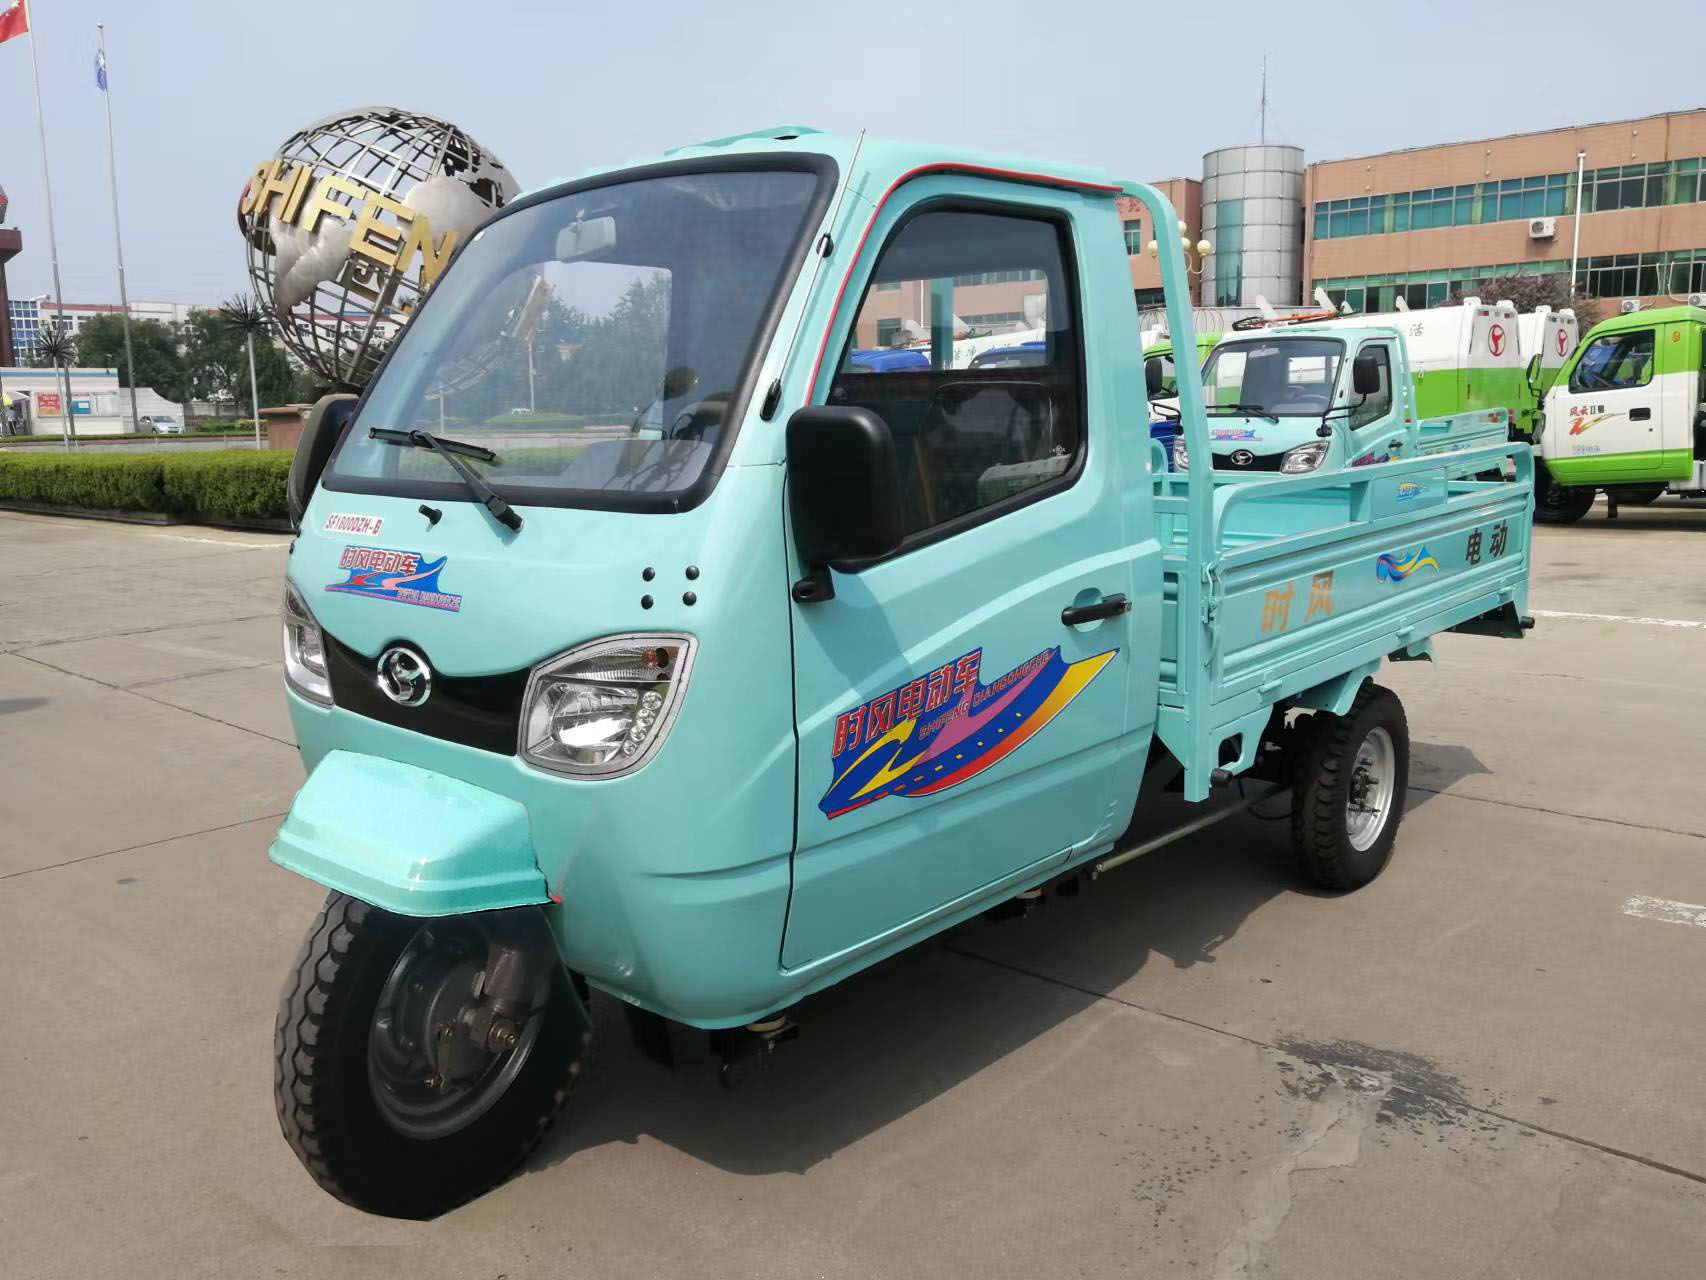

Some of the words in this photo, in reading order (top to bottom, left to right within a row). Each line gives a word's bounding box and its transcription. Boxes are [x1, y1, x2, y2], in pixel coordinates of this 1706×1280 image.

[340, 547, 418, 575] 时风电动车
[1260, 569, 1334, 634] 时风
[1465, 519, 1508, 565] 电动
[832, 650, 981, 758] 时风电动车
